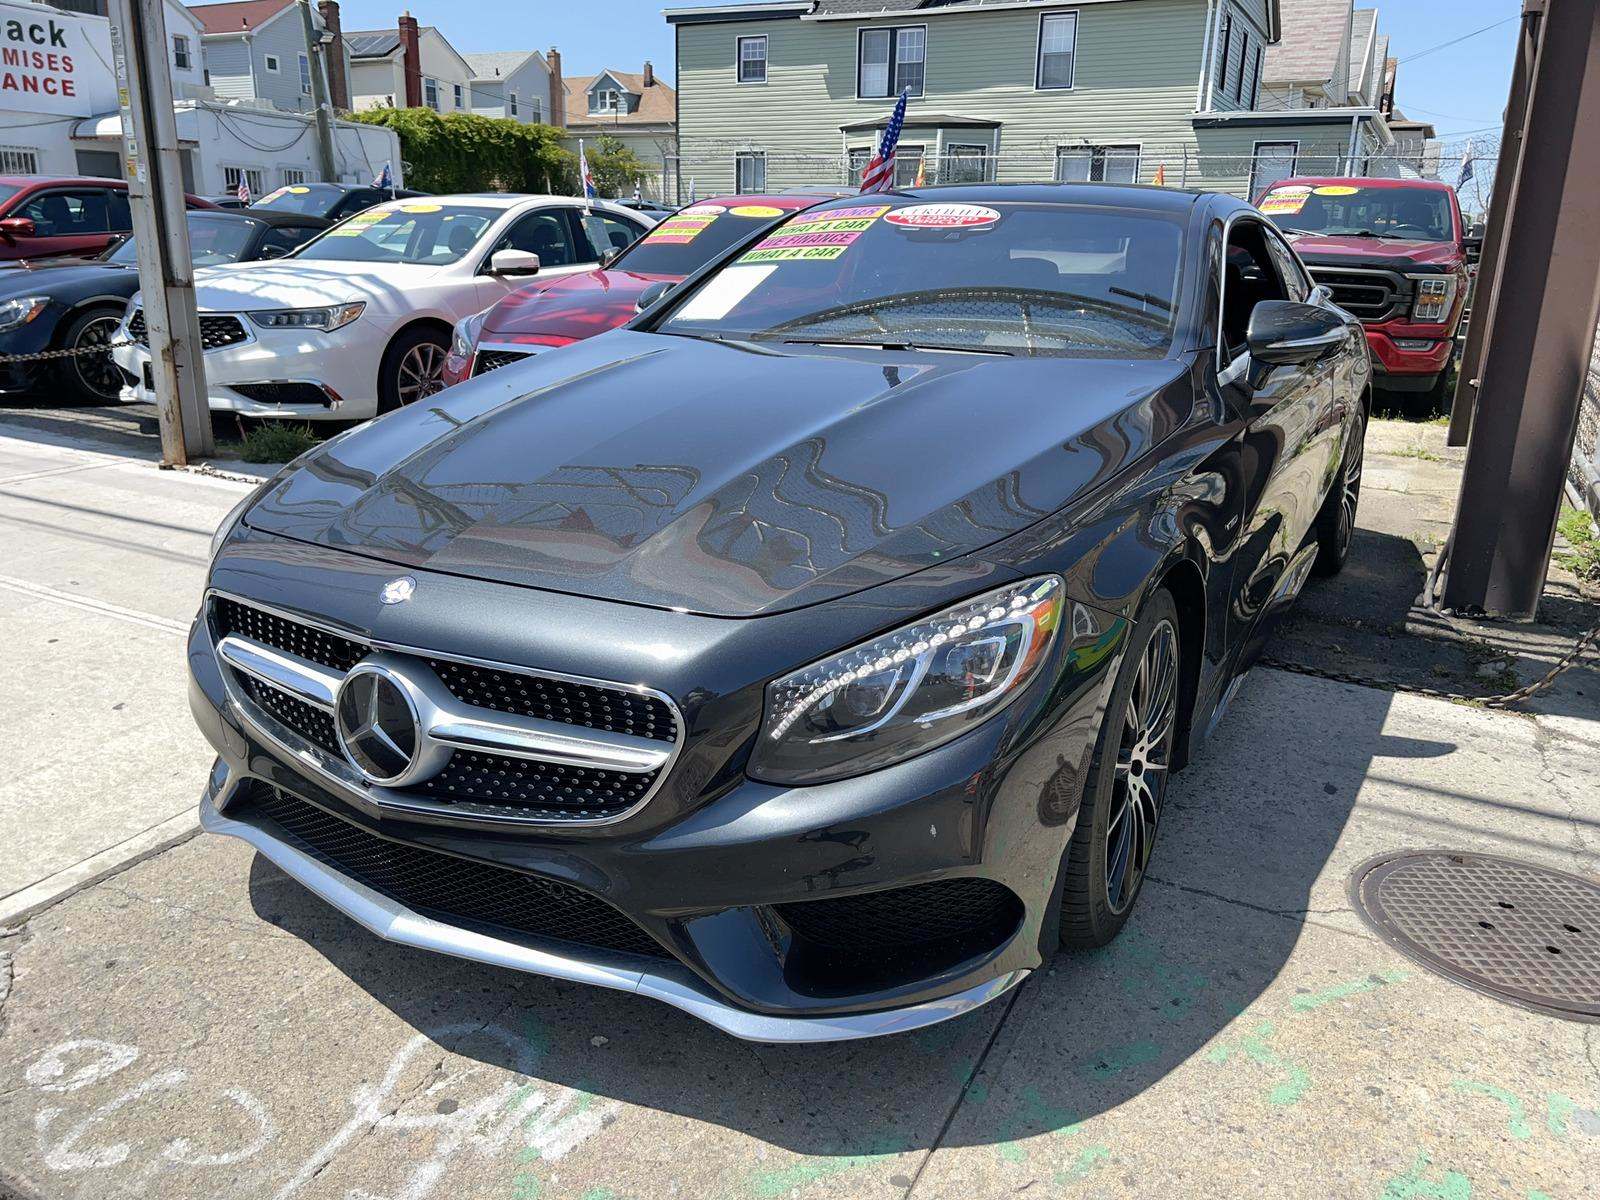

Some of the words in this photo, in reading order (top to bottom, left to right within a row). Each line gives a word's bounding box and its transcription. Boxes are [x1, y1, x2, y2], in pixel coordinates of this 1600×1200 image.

[0, 20, 67, 48] ack
[2, 72, 76, 97] ANCE
[774, 224, 816, 235] WHAT
[816, 223, 831, 231] A
[833, 220, 871, 231] CAR
[784, 233, 856, 245] FINANCE
[743, 250, 788, 260] WHAT
[803, 247, 843, 258] CAR
